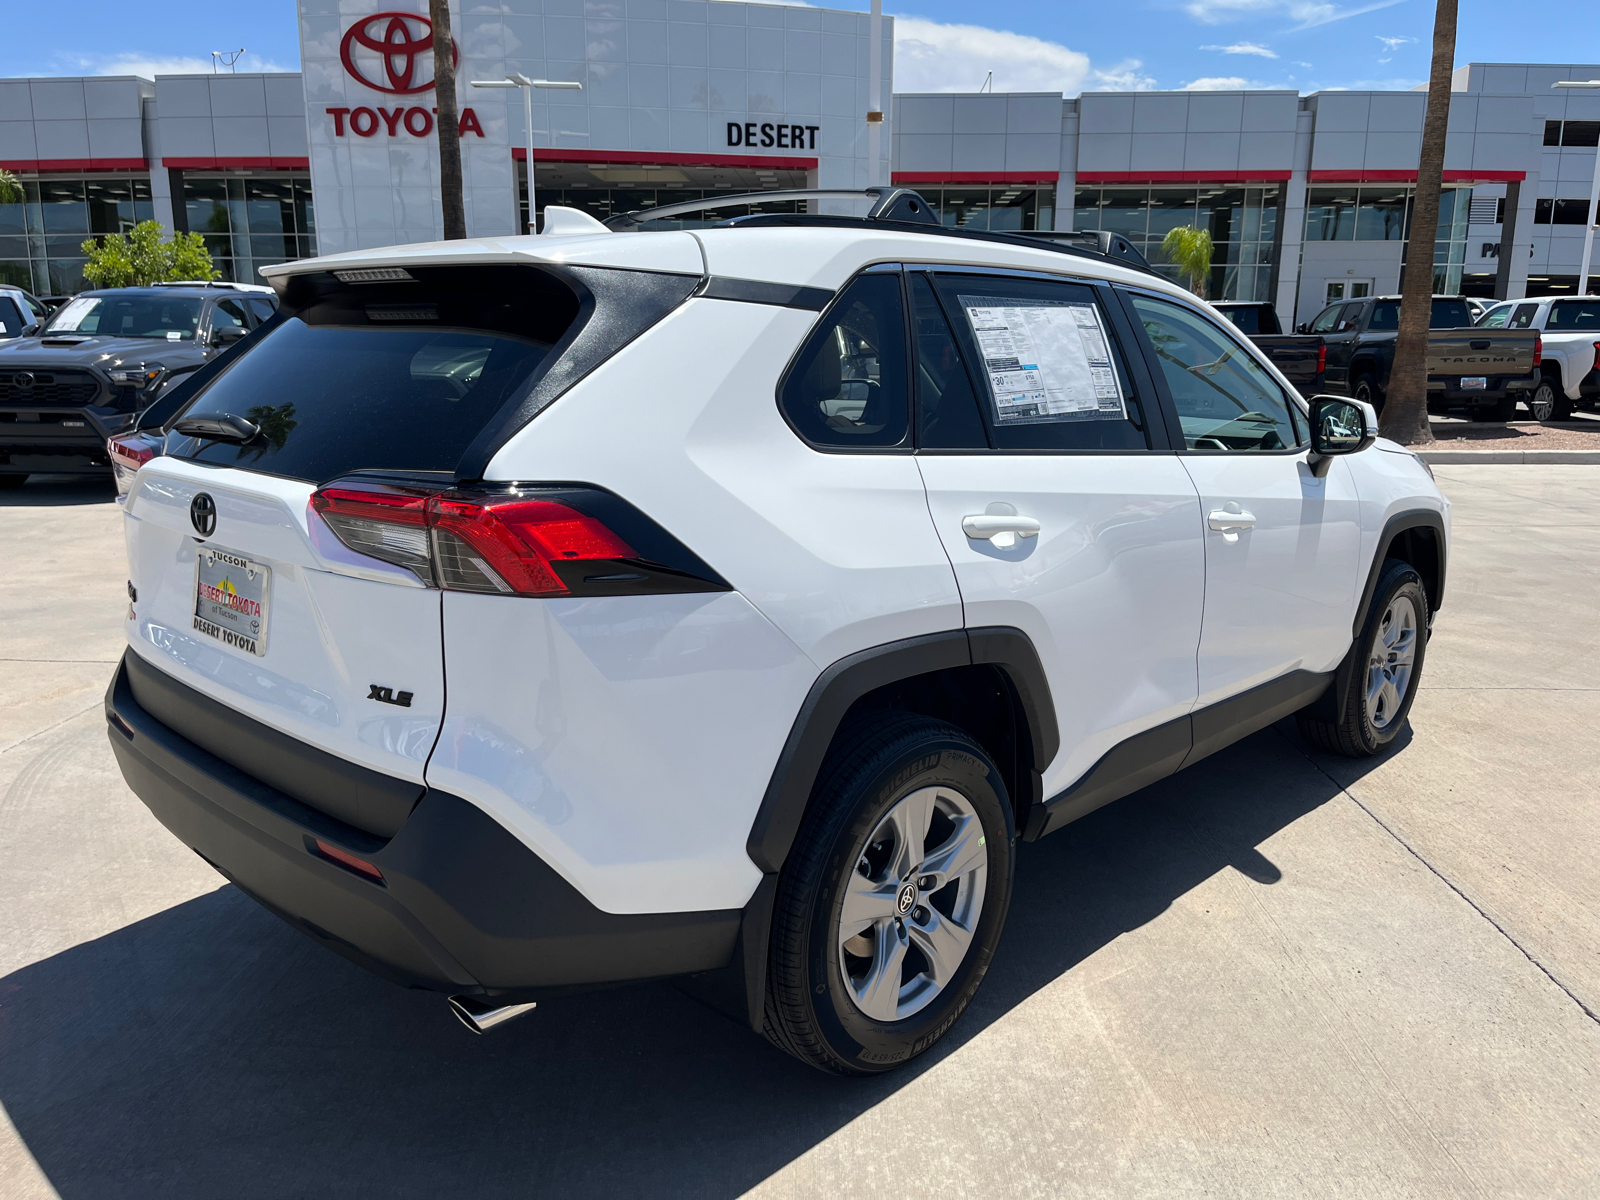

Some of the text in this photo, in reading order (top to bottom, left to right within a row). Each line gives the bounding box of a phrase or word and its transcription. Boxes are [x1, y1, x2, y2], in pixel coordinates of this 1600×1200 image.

[326, 106, 485, 138] TOYOA
[727, 122, 820, 150] DESERT
[995, 376, 1004, 386] 30
[212, 551, 247, 568] TUCSON
[200, 581, 261, 618] DESERT TOYOTA
[212, 605, 238, 622] of Tucson
[193, 617, 257, 655] DESERT TOYOTA
[366, 683, 414, 708] XLE
[947, 752, 977, 766] PRIMACY
[879, 753, 939, 804] MICHELIN
[914, 996, 968, 1055] MICHELIN
[878, 1050, 905, 1062] 225/65
